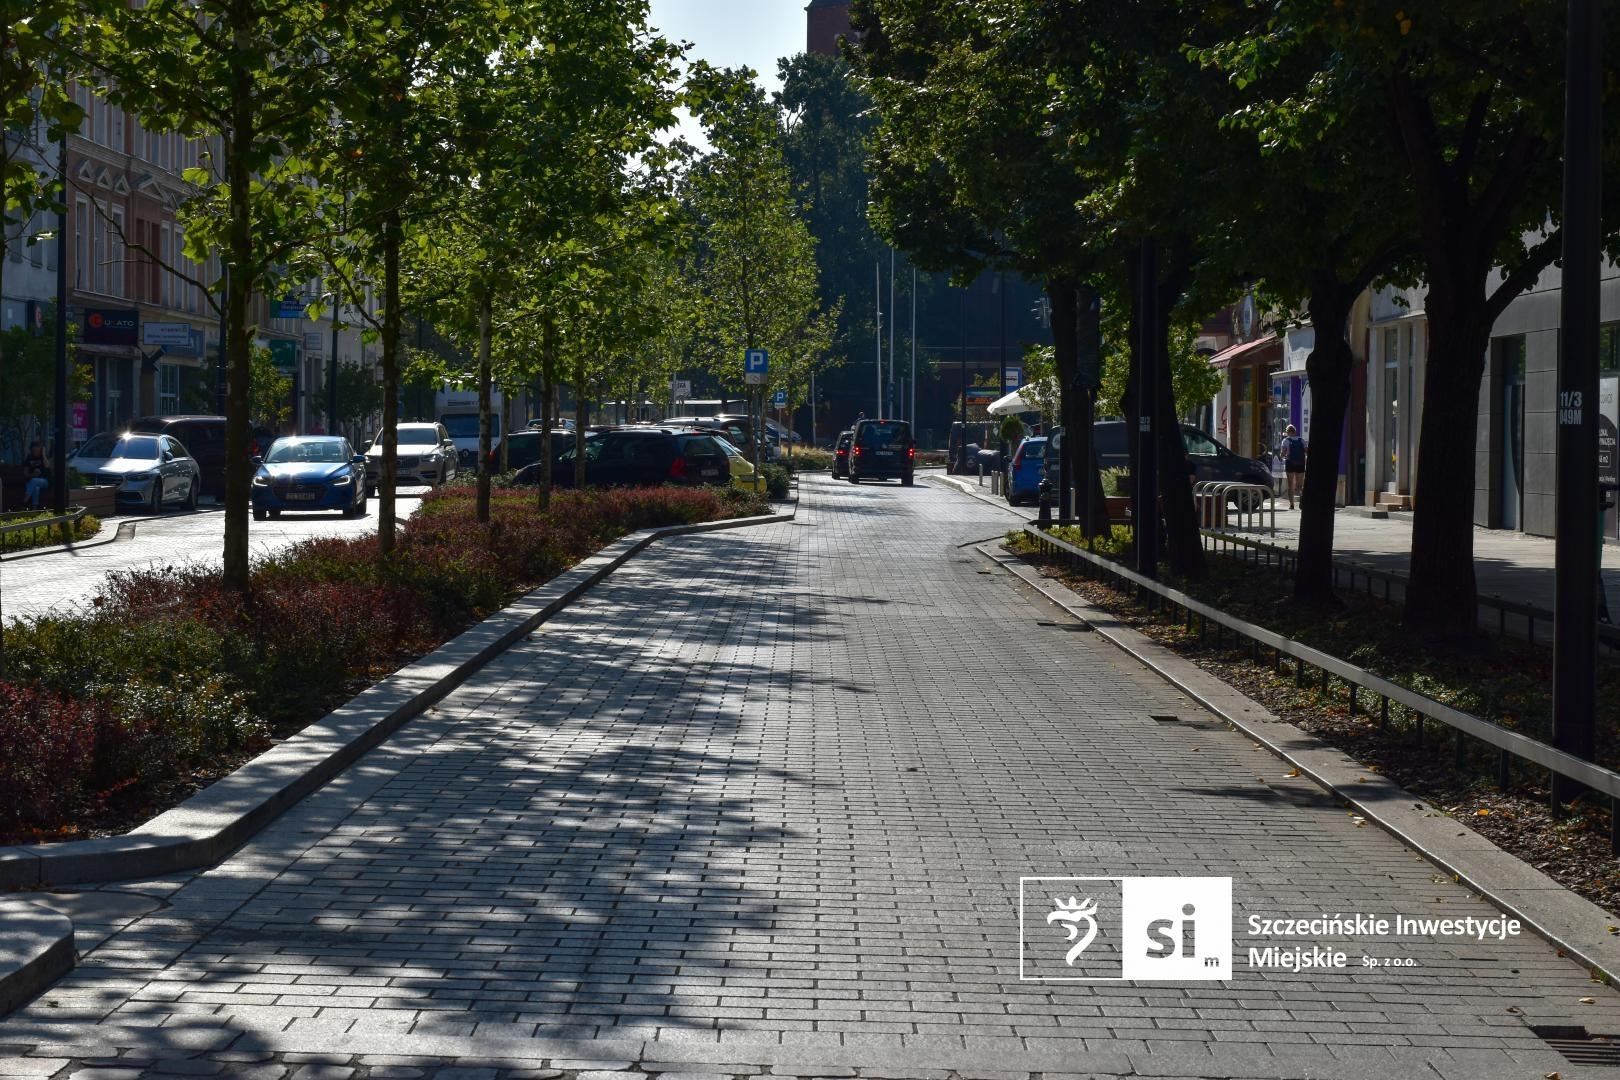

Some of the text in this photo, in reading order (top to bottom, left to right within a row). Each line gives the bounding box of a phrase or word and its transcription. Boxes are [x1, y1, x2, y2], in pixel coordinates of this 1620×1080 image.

[750, 352, 763, 370] P
[776, 392, 784, 402] P
[1560, 391, 1582, 408] 11/3
